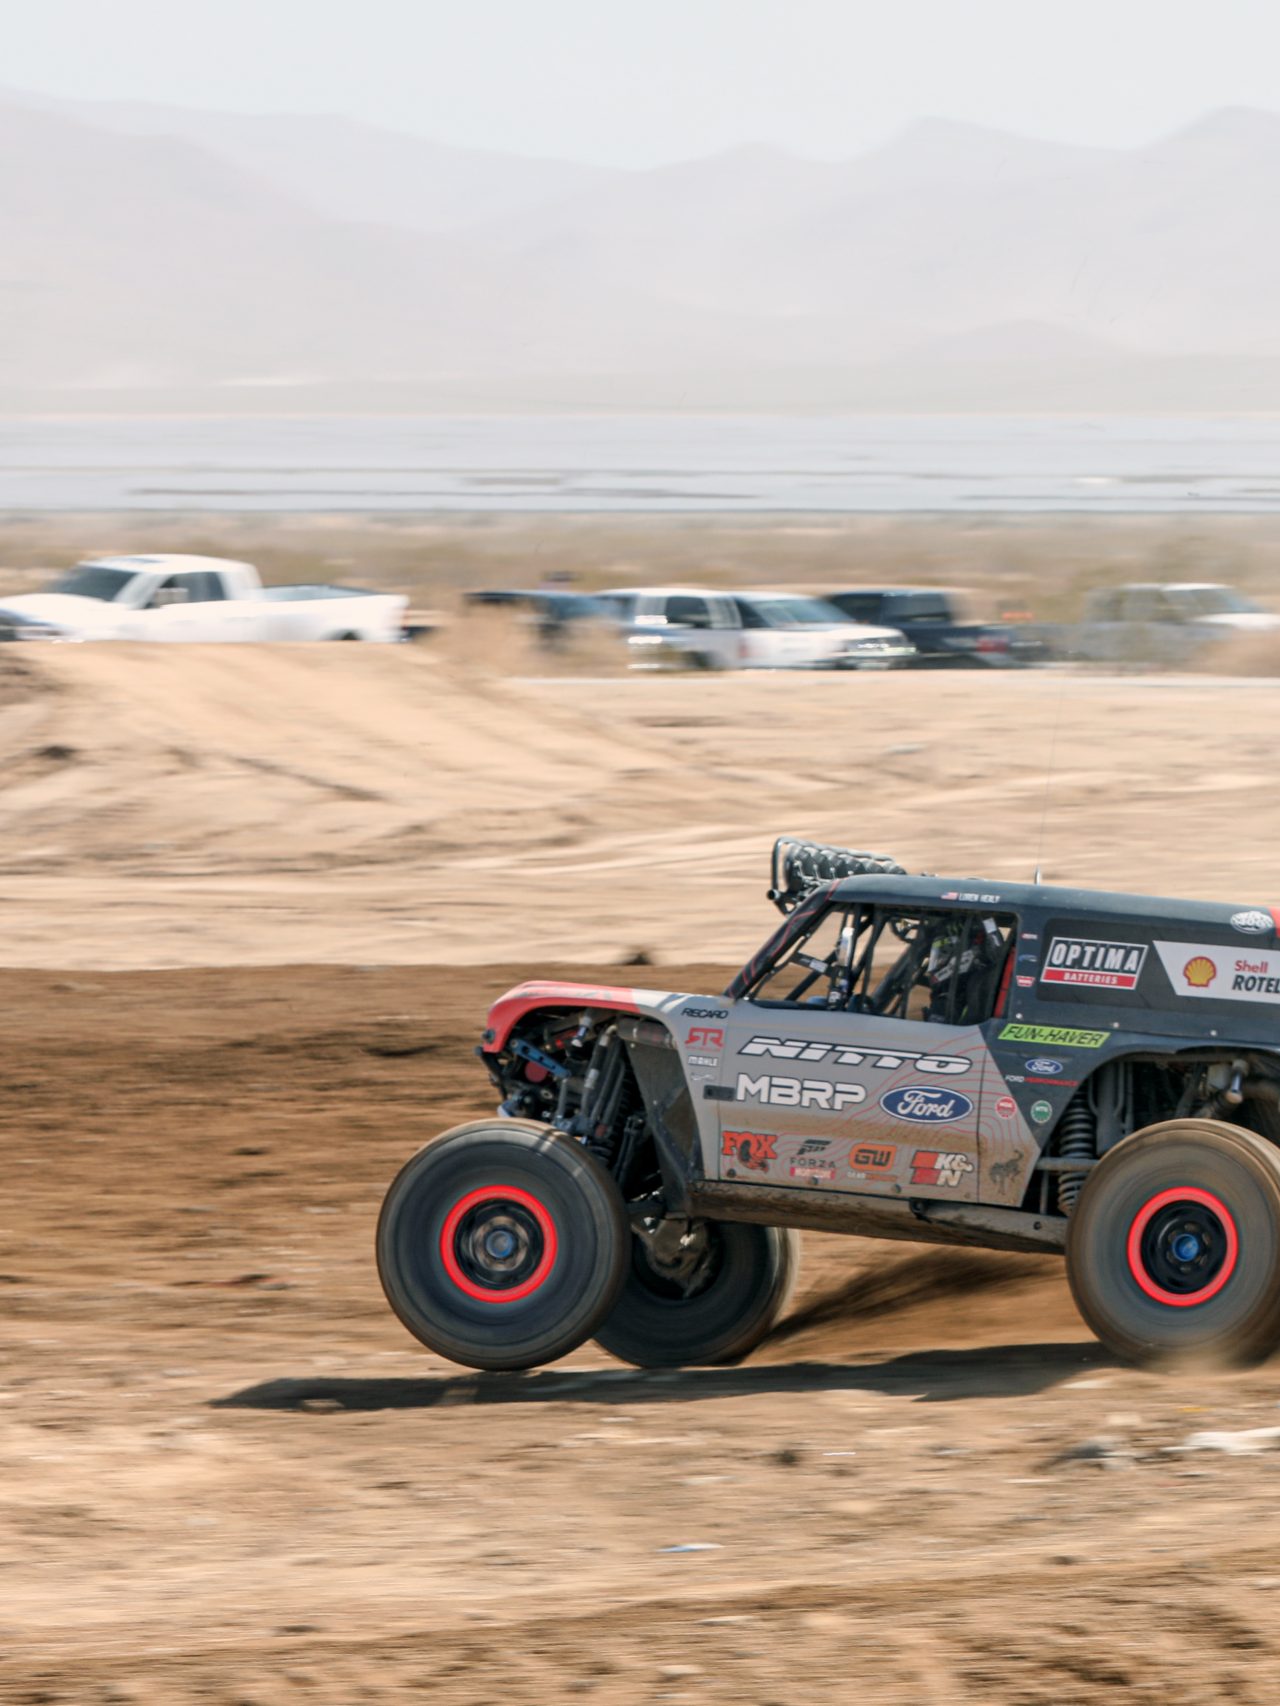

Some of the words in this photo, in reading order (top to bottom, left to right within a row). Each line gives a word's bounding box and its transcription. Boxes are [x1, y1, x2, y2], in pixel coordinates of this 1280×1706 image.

[1051, 943, 1139, 971] OPTIMA
[1235, 960, 1268, 974] Shell
[1063, 972, 1118, 985] BATTERIES
[681, 1007, 728, 1019] RECARO
[1003, 1026, 1104, 1045] FUN-HAVER
[738, 1035, 973, 1075] NITTO
[1031, 1060, 1057, 1073] Ford
[736, 1072, 867, 1112] MBRP
[897, 1090, 955, 1119] Ford
[722, 1131, 778, 1161] FOX
[790, 1157, 836, 1169] FORZA
[855, 1148, 892, 1166] GW
